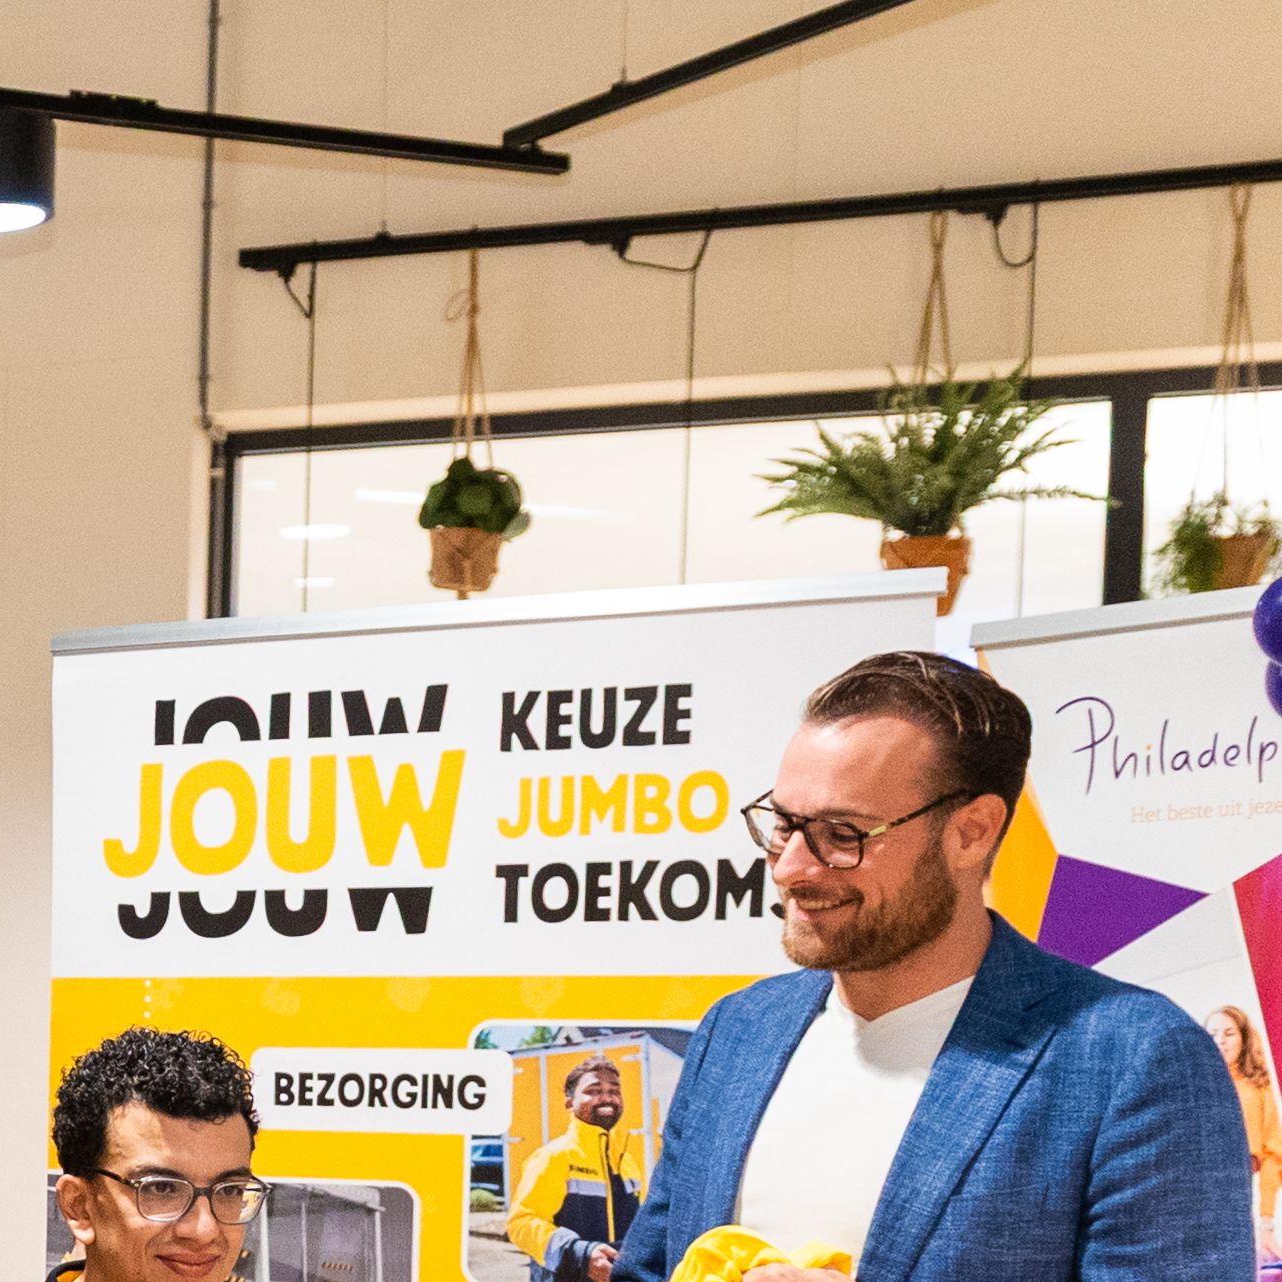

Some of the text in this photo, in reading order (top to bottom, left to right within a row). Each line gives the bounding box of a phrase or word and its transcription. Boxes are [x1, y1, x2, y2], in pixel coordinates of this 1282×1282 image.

[500, 683, 693, 752] KEUZE
[103, 748, 466, 878] JOUW
[497, 769, 730, 838] JUMBO
[1131, 806, 1163, 823] Het
[1167, 804, 1213, 821] beste
[1218, 799, 1243, 817] uit
[495, 857, 785, 923] TOEKOM
[274, 1072, 488, 1111] BEZORGING
